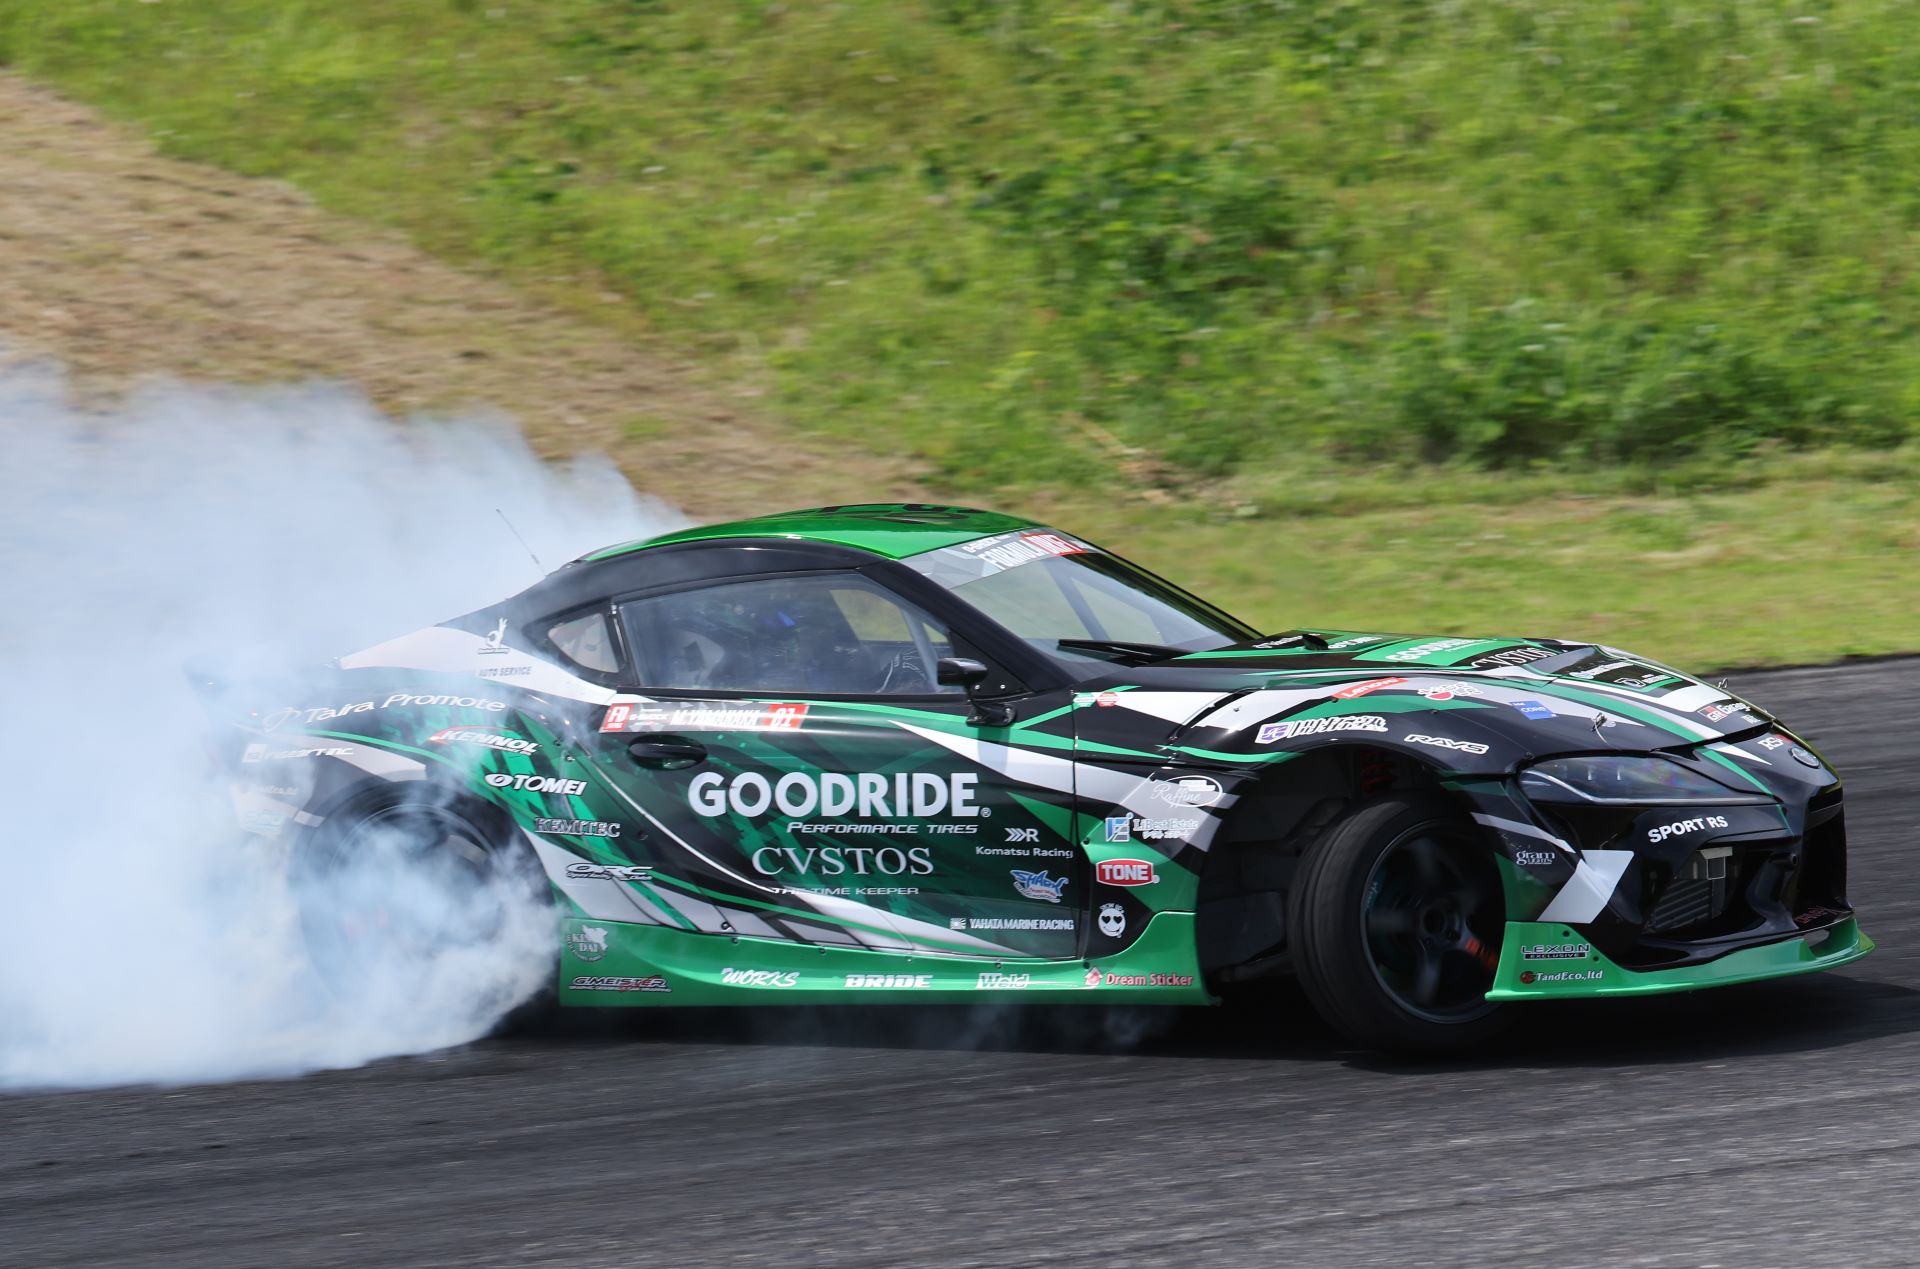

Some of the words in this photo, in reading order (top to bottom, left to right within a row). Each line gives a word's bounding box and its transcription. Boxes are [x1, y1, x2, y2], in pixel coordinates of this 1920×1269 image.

[305, 701, 376, 723] Taira
[382, 694, 507, 712] Promote
[440, 731, 542, 754] KENNOL
[1404, 734, 1490, 754] RAYS
[513, 774, 587, 796] TOMEI
[688, 771, 980, 818] GOODRIDE
[534, 818, 621, 838] KEMITEC
[786, 821, 919, 834] PERFORMANCE
[926, 824, 979, 834] TIRES
[1648, 817, 1704, 843] SPORT
[1706, 815, 1729, 830] RS
[975, 846, 1031, 857] Komatsu
[1033, 847, 1074, 858] Racing
[1516, 850, 1556, 866] gram
[751, 847, 935, 876] CVSTOS
[1101, 864, 1149, 881] TONE
[811, 887, 851, 896] TIME
[856, 887, 920, 896] KEEPER
[1521, 943, 1590, 953] LEXON
[721, 967, 800, 988] WORKS
[844, 974, 934, 988] BRIDE
[978, 973, 1030, 988] Weld
[1105, 973, 1146, 986] Dream
[1149, 973, 1193, 986] Sticker
